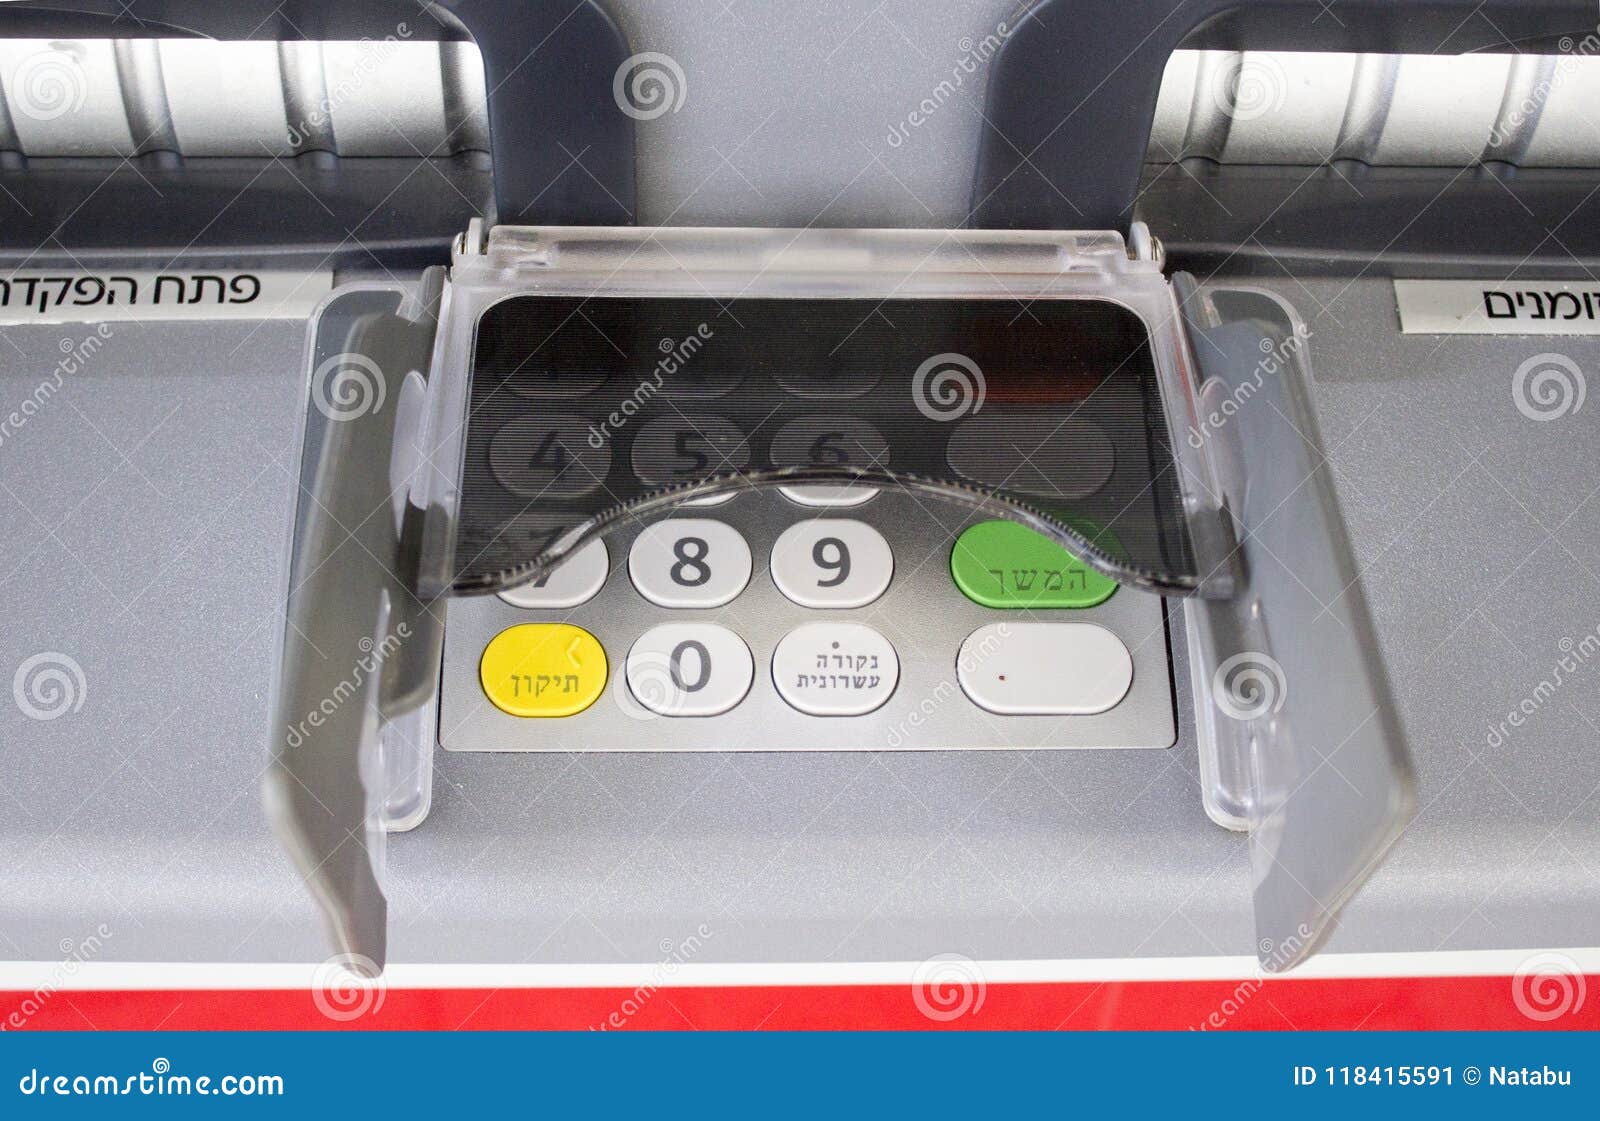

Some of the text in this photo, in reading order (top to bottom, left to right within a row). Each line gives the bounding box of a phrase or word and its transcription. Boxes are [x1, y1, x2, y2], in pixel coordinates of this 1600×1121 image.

[0, 274, 261, 313] פתח הפקד
[528, 429, 570, 484] 4
[673, 431, 709, 474] 5
[807, 431, 850, 468] 6
[669, 536, 712, 587] 8
[811, 536, 852, 588] 9
[989, 569, 1086, 595] המשך
[511, 674, 579, 698] תיקון
[668, 639, 713, 693] 0
[796, 674, 881, 689] עשרונית
